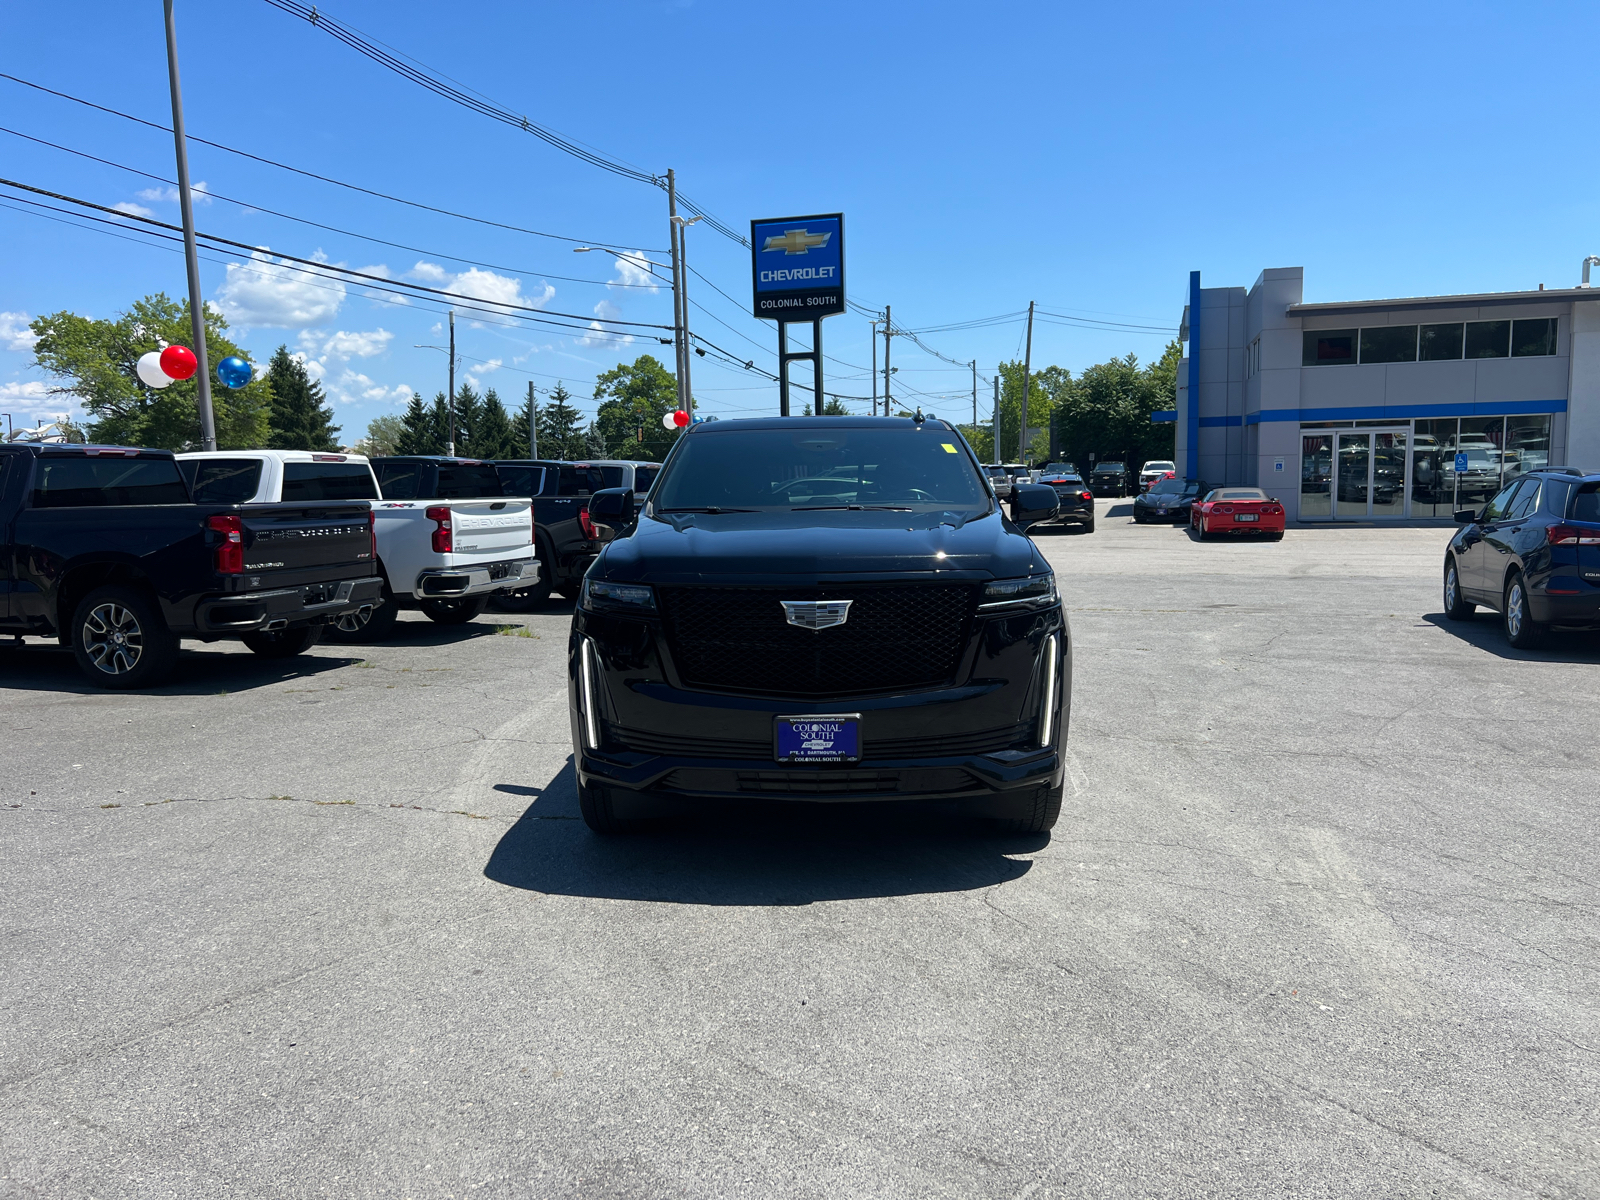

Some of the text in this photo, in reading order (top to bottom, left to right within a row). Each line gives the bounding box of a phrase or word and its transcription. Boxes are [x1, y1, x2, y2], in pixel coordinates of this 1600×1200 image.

[761, 266, 836, 282] CHEVROLET
[761, 296, 837, 309] COLONIAL SOUTH
[460, 516, 531, 529] CHEVROLET
[792, 723, 842, 732] COLONIAL
[800, 731, 834, 740] SOUTH
